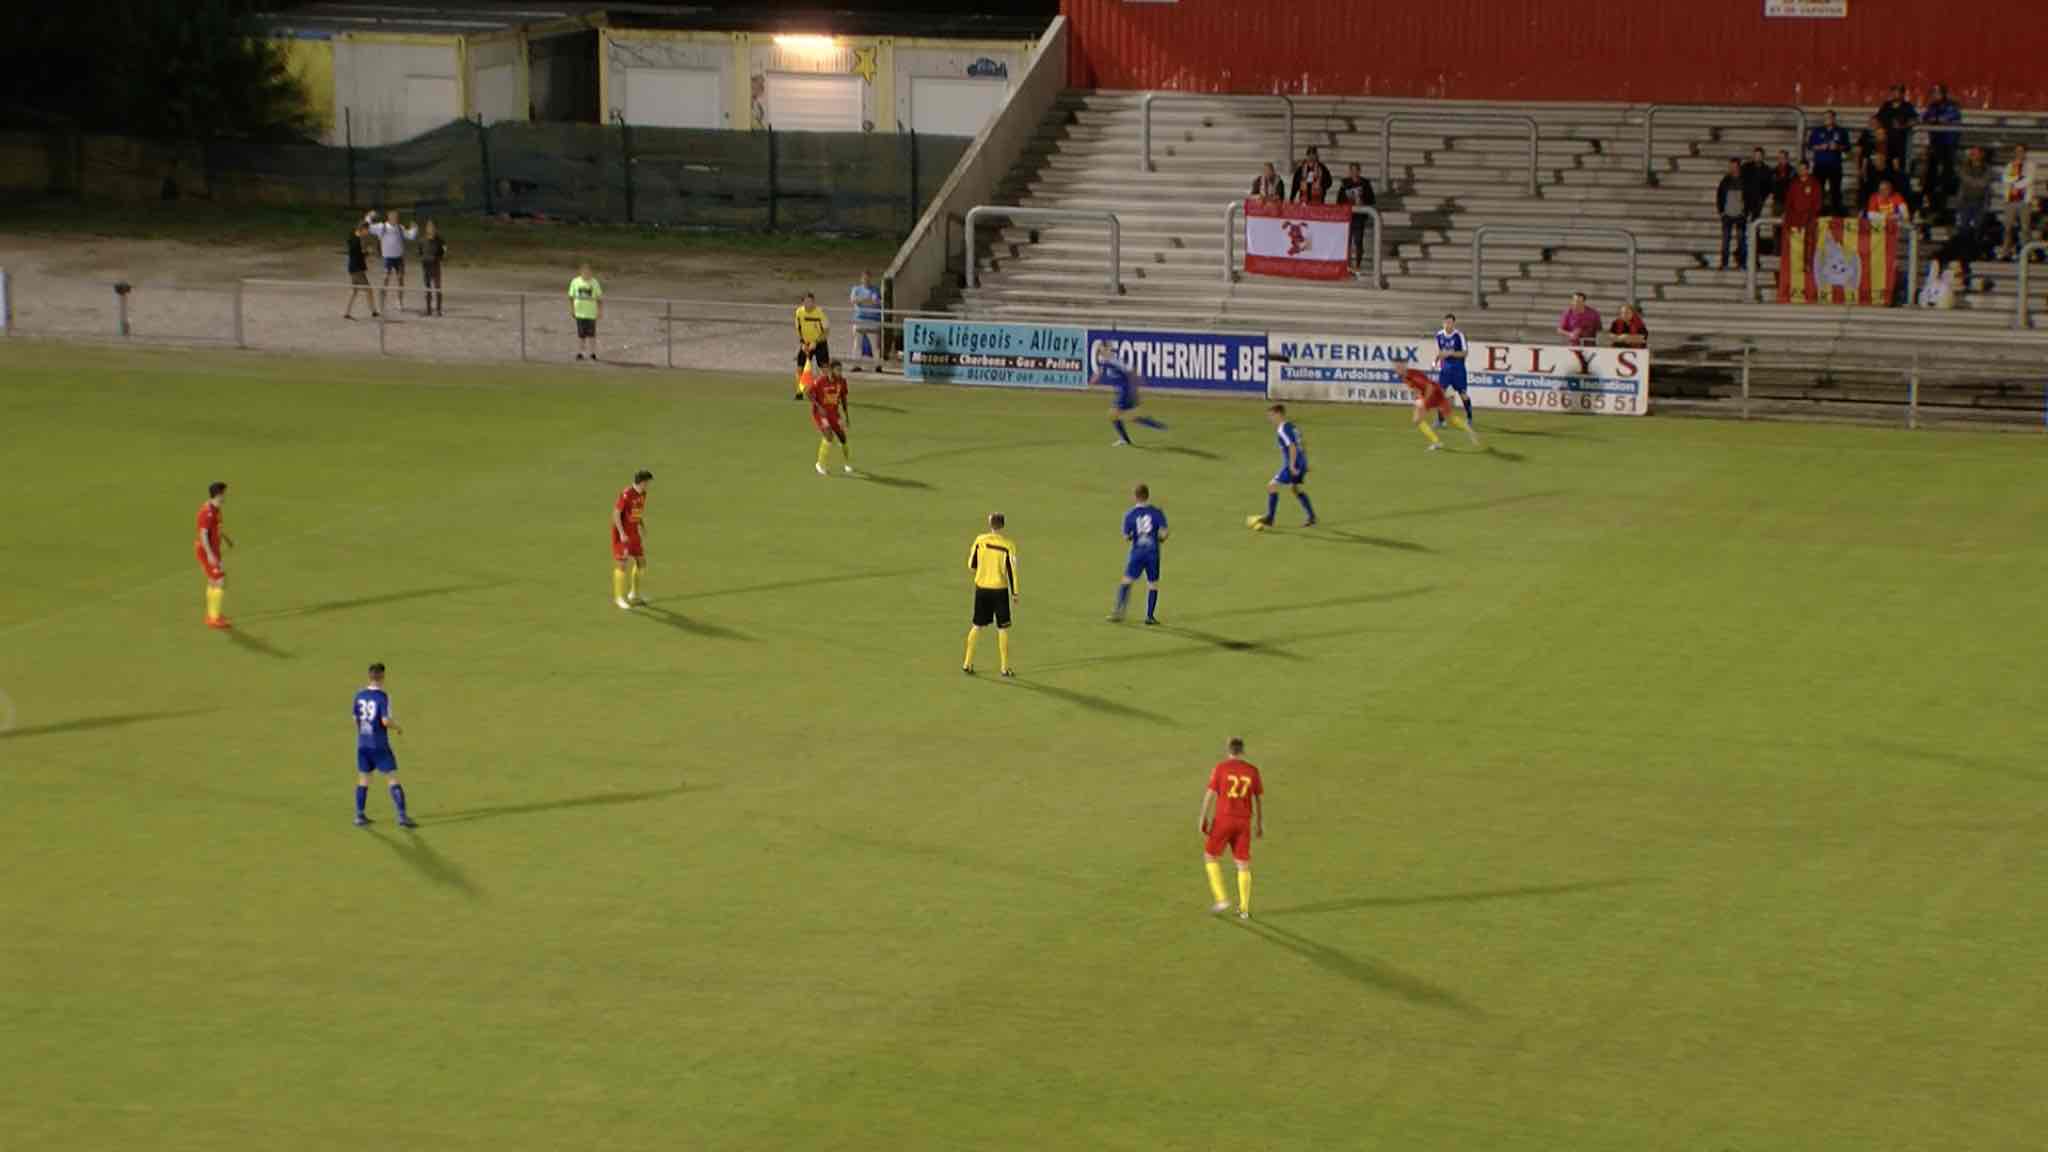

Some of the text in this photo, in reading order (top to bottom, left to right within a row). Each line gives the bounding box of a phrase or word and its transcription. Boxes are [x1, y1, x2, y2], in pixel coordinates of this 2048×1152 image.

[948, 325, 1012, 351] Liégeois
[1030, 329, 1079, 355] Allary
[959, 353, 1006, 367] Charbons
[1045, 357, 1081, 371] Pellets
[1281, 342, 1639, 378] MATERIAUX ELYS
[967, 367, 1014, 382] BLICQUY
[1286, 367, 1322, 380] Tuiles
[1333, 368, 1390, 383] Ardoises
[1466, 372, 1494, 384] Bois
[1348, 387, 1637, 412] FRASNE 069/86 65 51
[357, 699, 377, 721] 39
[1227, 775, 1252, 798] 27
